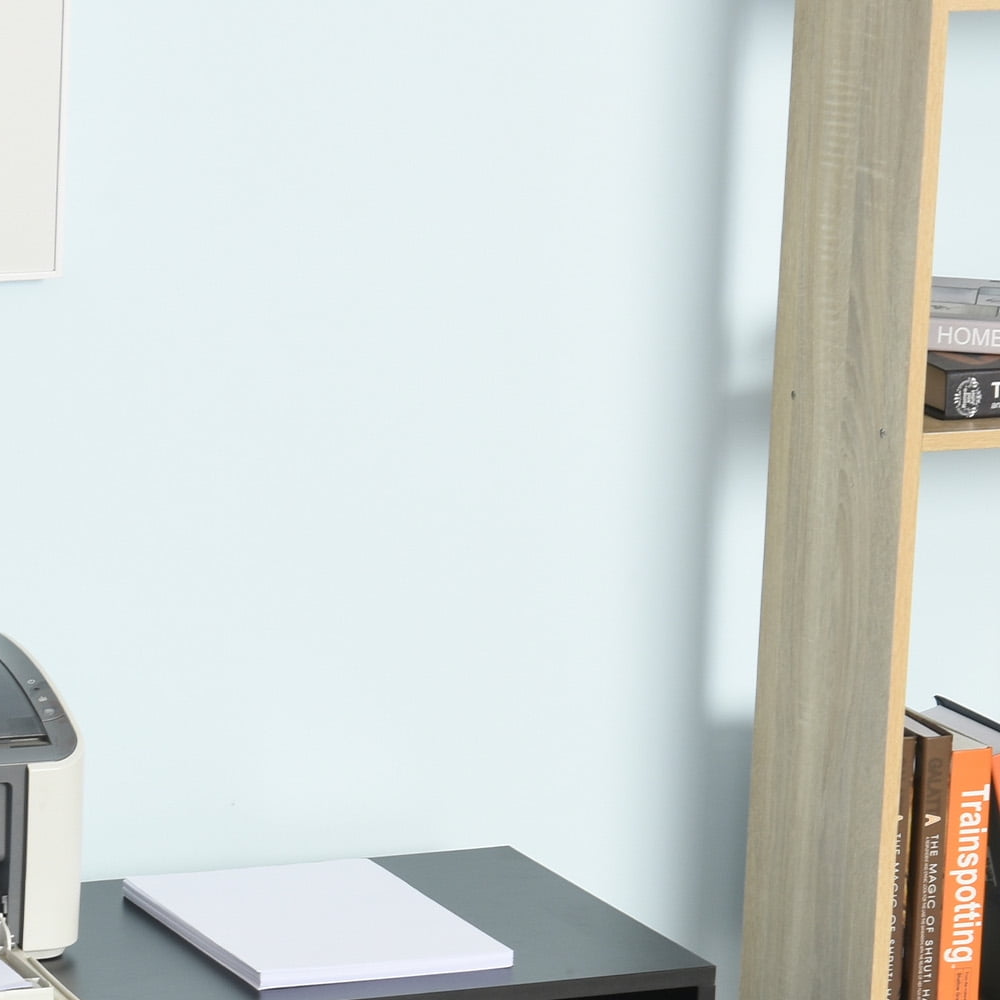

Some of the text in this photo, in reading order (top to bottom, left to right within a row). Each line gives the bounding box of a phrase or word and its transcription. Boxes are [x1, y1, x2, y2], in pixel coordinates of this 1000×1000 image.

[929, 833, 940, 857] THE
[926, 863, 938, 909] MAGIC
[925, 915, 936, 933] OF
[923, 939, 934, 983] SHRUTI
